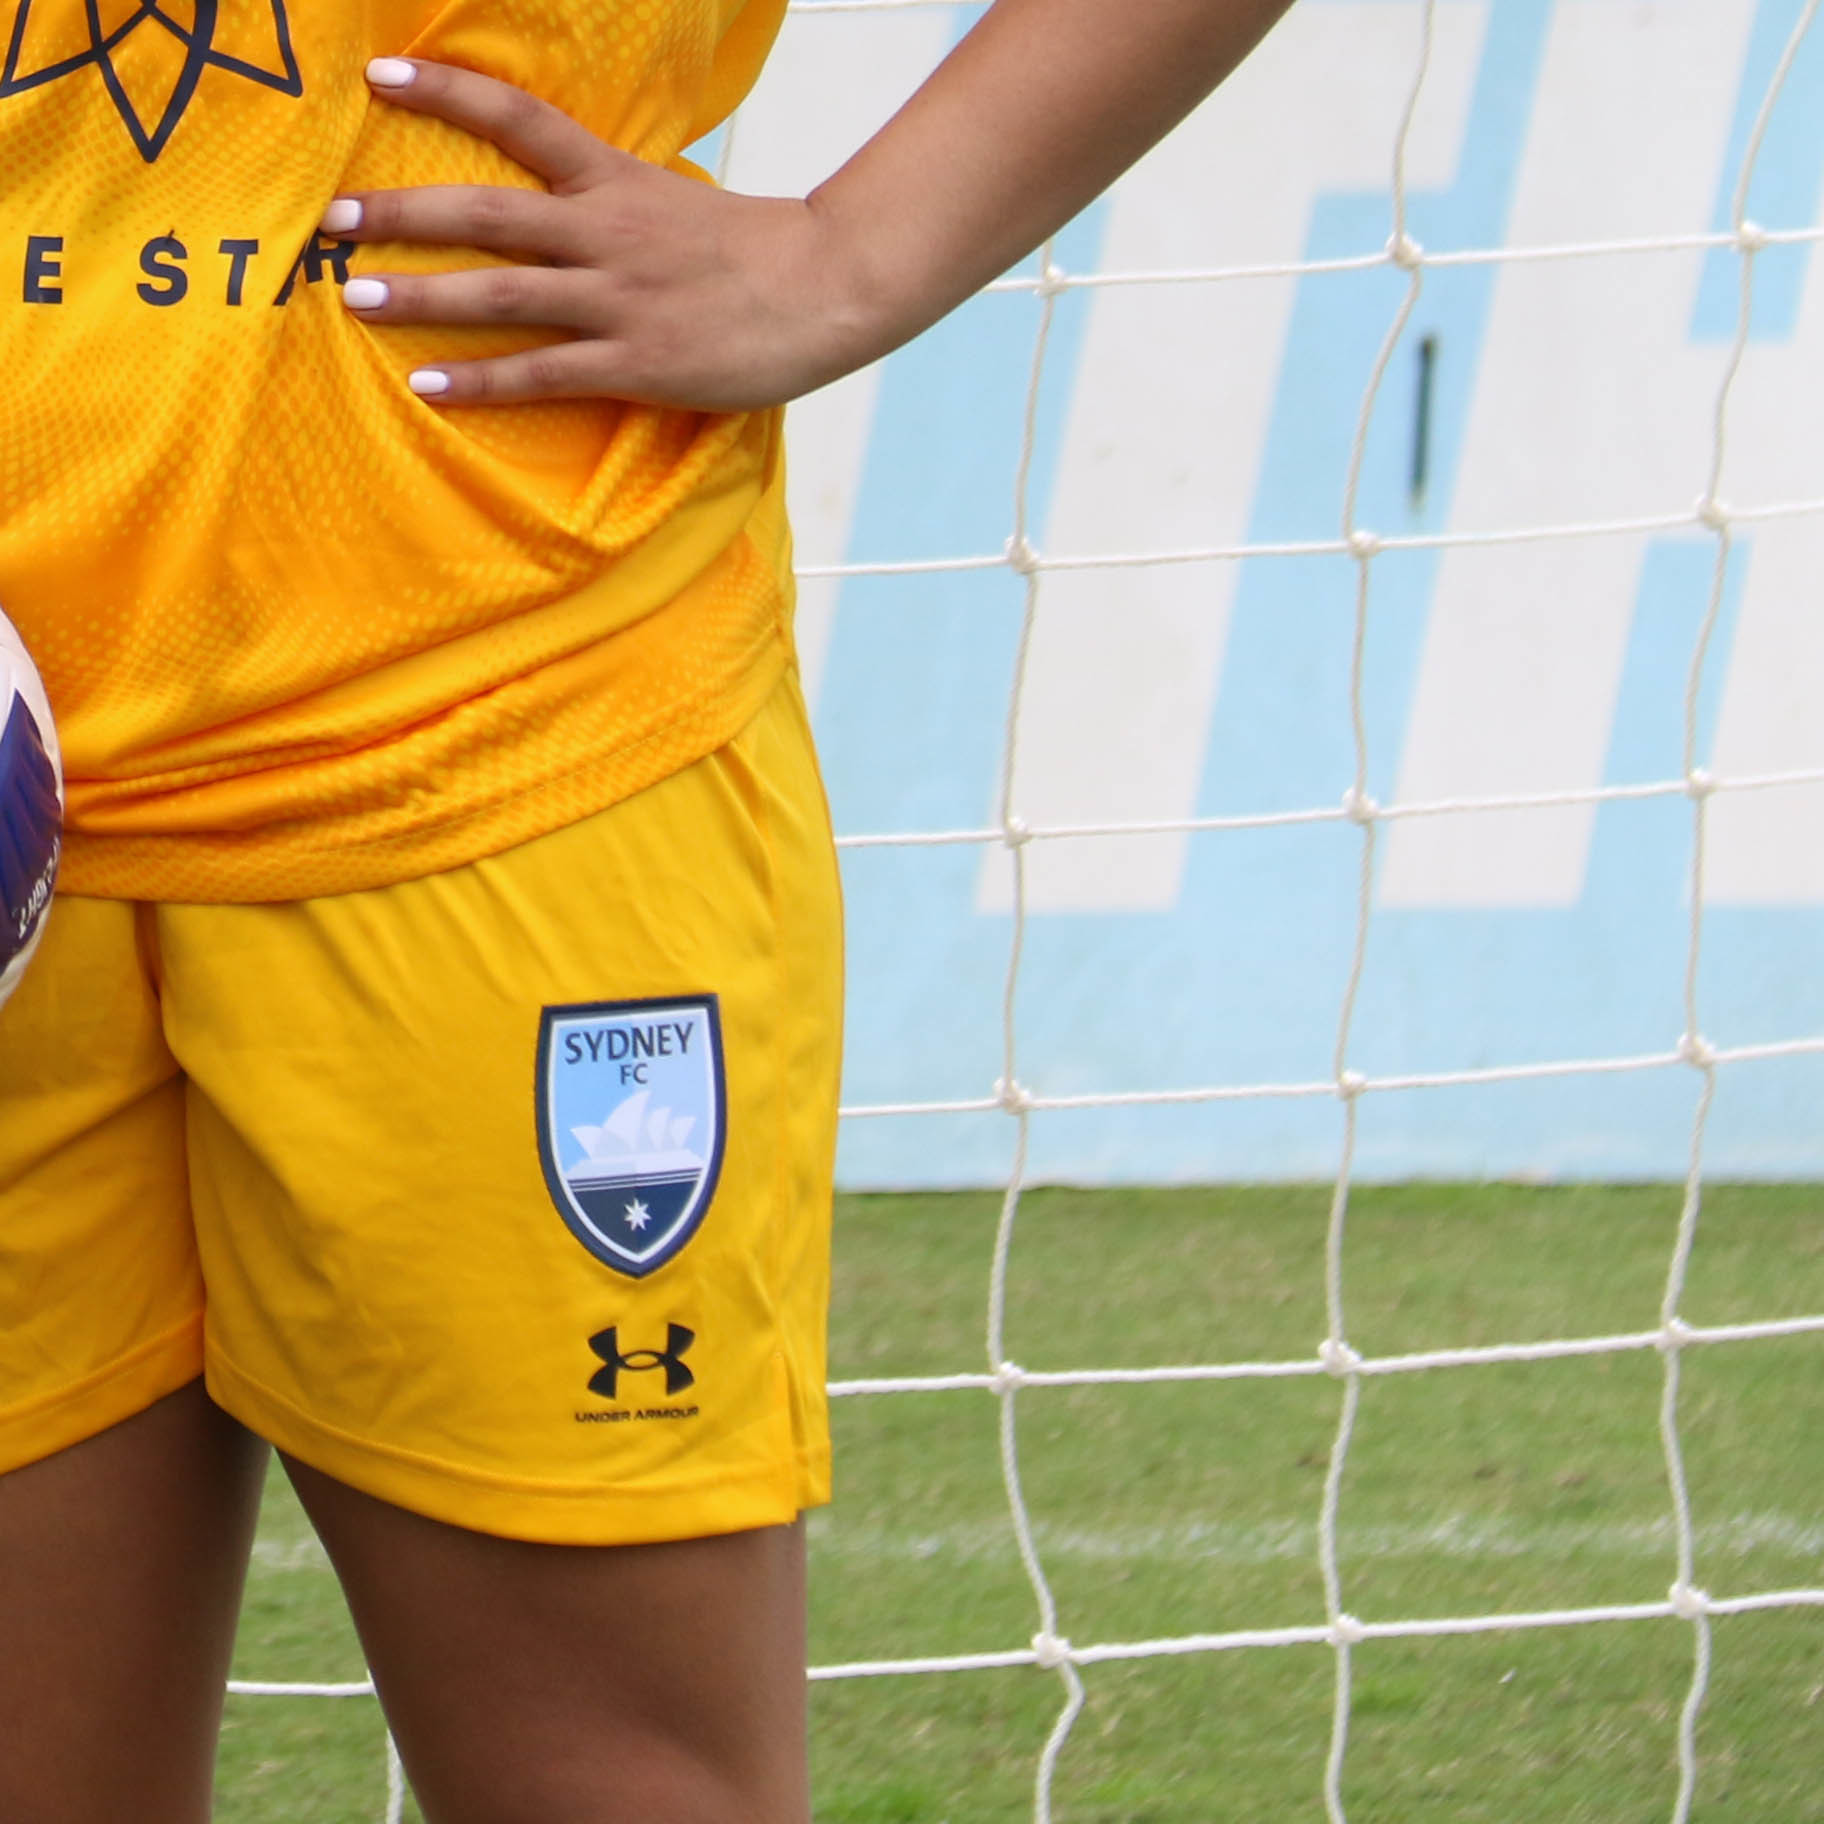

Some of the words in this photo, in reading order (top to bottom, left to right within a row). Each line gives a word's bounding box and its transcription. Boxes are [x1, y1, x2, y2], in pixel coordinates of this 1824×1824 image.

[564, 1021, 695, 1065] SYDNEY
[619, 1062, 649, 1087] FC
[575, 1410, 631, 1423] UNDER
[633, 1405, 699, 1421] ARMOUR
